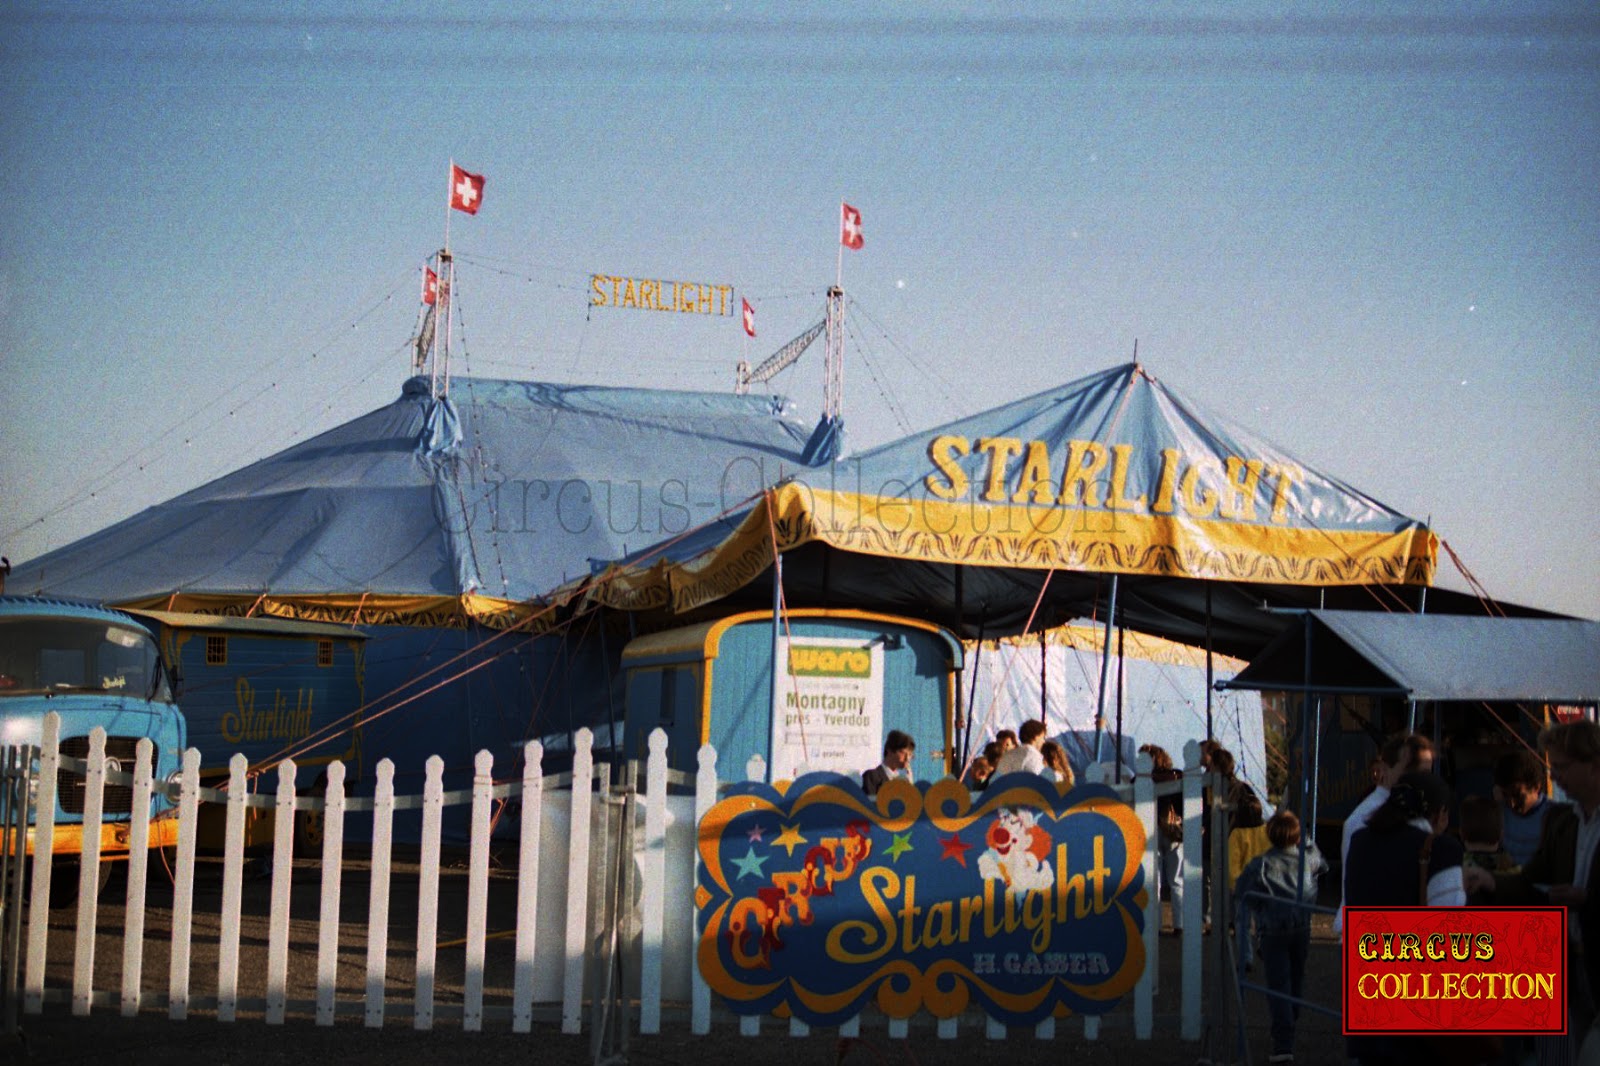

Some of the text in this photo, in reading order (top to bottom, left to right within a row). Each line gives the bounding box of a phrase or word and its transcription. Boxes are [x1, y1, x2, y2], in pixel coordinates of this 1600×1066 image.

[591, 274, 731, 316] STARLIGHT
[925, 434, 1305, 525] STARLIGHT
[789, 649, 869, 673] waro
[222, 676, 314, 747] Starlight
[786, 692, 866, 713] Montagny
[725, 820, 1112, 970] CIRCUS Starlight
